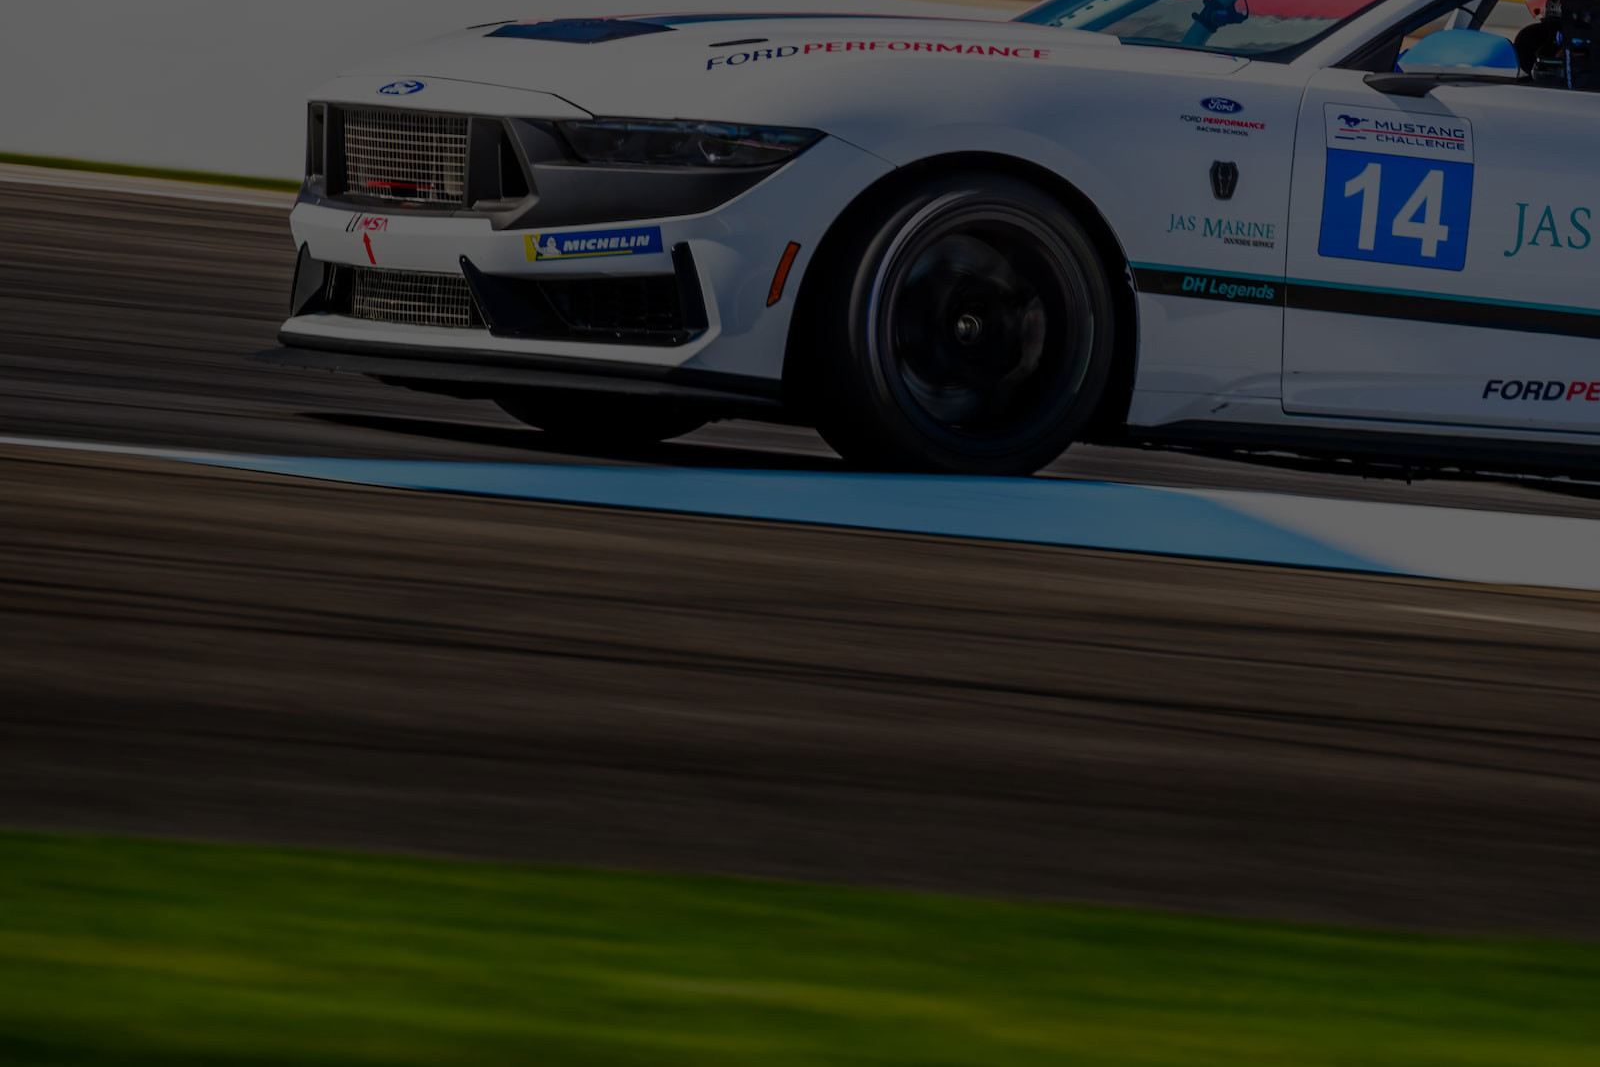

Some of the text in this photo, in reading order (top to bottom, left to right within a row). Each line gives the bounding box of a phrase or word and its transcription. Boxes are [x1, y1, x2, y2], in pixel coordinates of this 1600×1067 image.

[1180, 114, 1265, 130] FORD PERFORMANCE
[1375, 120, 1465, 139] MUSTANG
[1376, 134, 1466, 151] CHALLENGE
[1343, 161, 1450, 259] 14
[1166, 213, 1276, 240] JAS MARINE
[1503, 202, 1592, 257] JAS
[563, 234, 650, 252] MICHELIN
[1182, 275, 1275, 301] DH Legends
